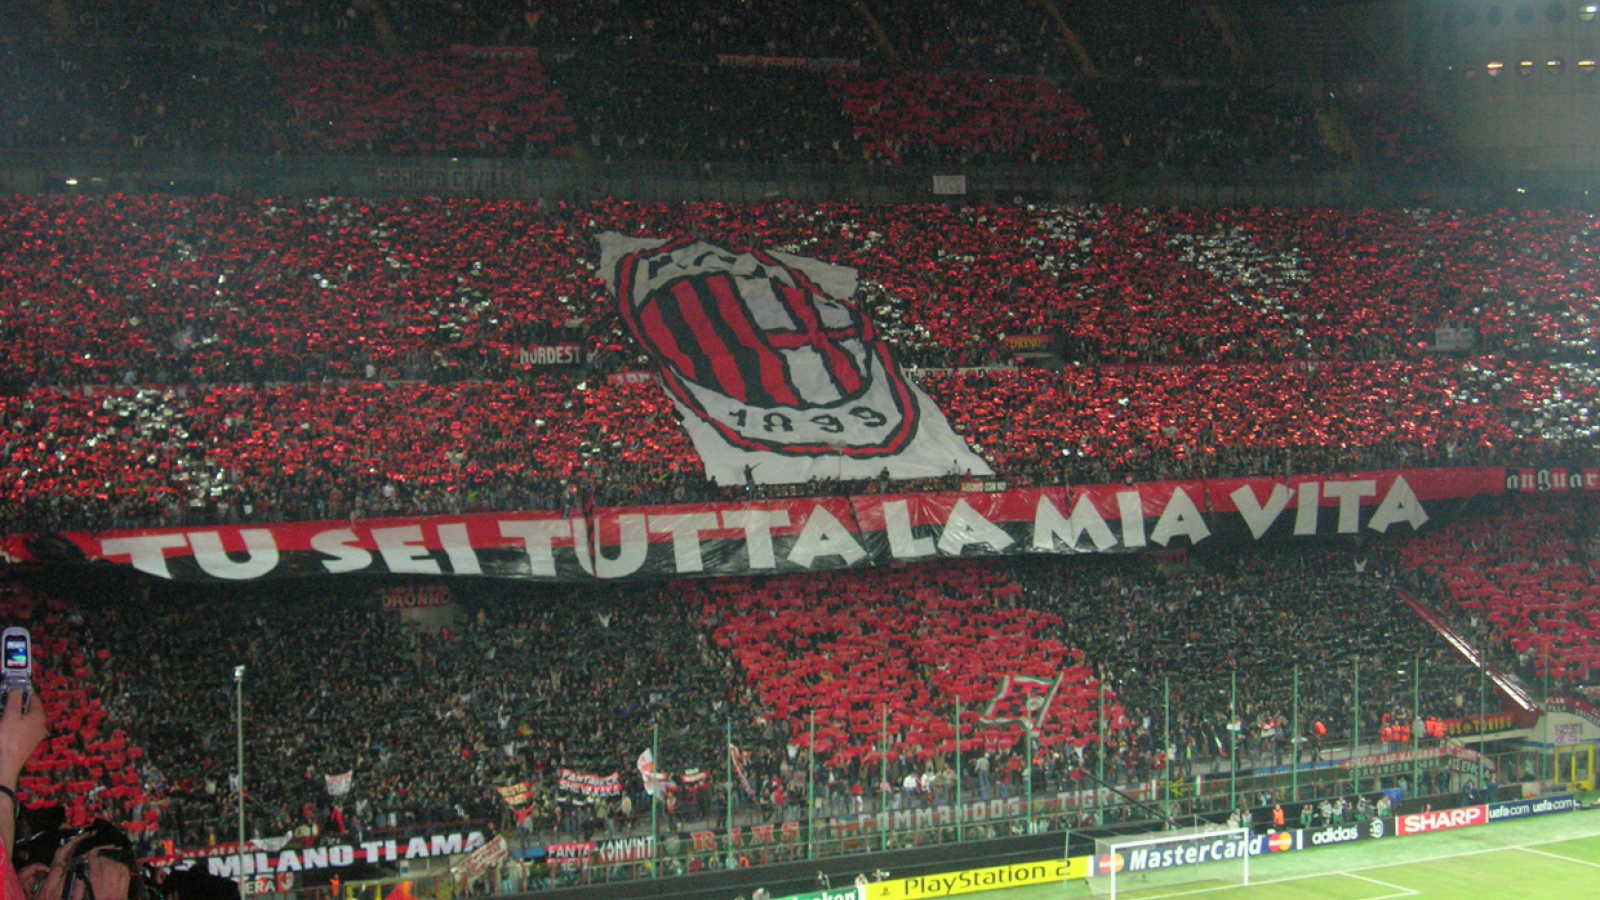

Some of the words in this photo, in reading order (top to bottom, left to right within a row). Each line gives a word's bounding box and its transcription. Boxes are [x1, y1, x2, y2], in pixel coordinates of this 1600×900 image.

[101, 528, 280, 579] TU
[311, 523, 482, 575] SEI
[498, 503, 868, 579] TUTTA
[883, 498, 1015, 559] LA
[1033, 486, 1212, 551] MIA
[1230, 474, 1430, 540] VITA
[857, 796, 1021, 832] COMMANDOS
[1404, 808, 1481, 833] SHARP
[209, 844, 354, 876] MILANO
[360, 839, 397, 863] TI
[405, 831, 485, 859] AMA
[1129, 834, 1263, 871] MasterCard
[1312, 825, 1358, 845] adidas
[904, 864, 1045, 896] PlayStation
[1055, 859, 1072, 877] 2
